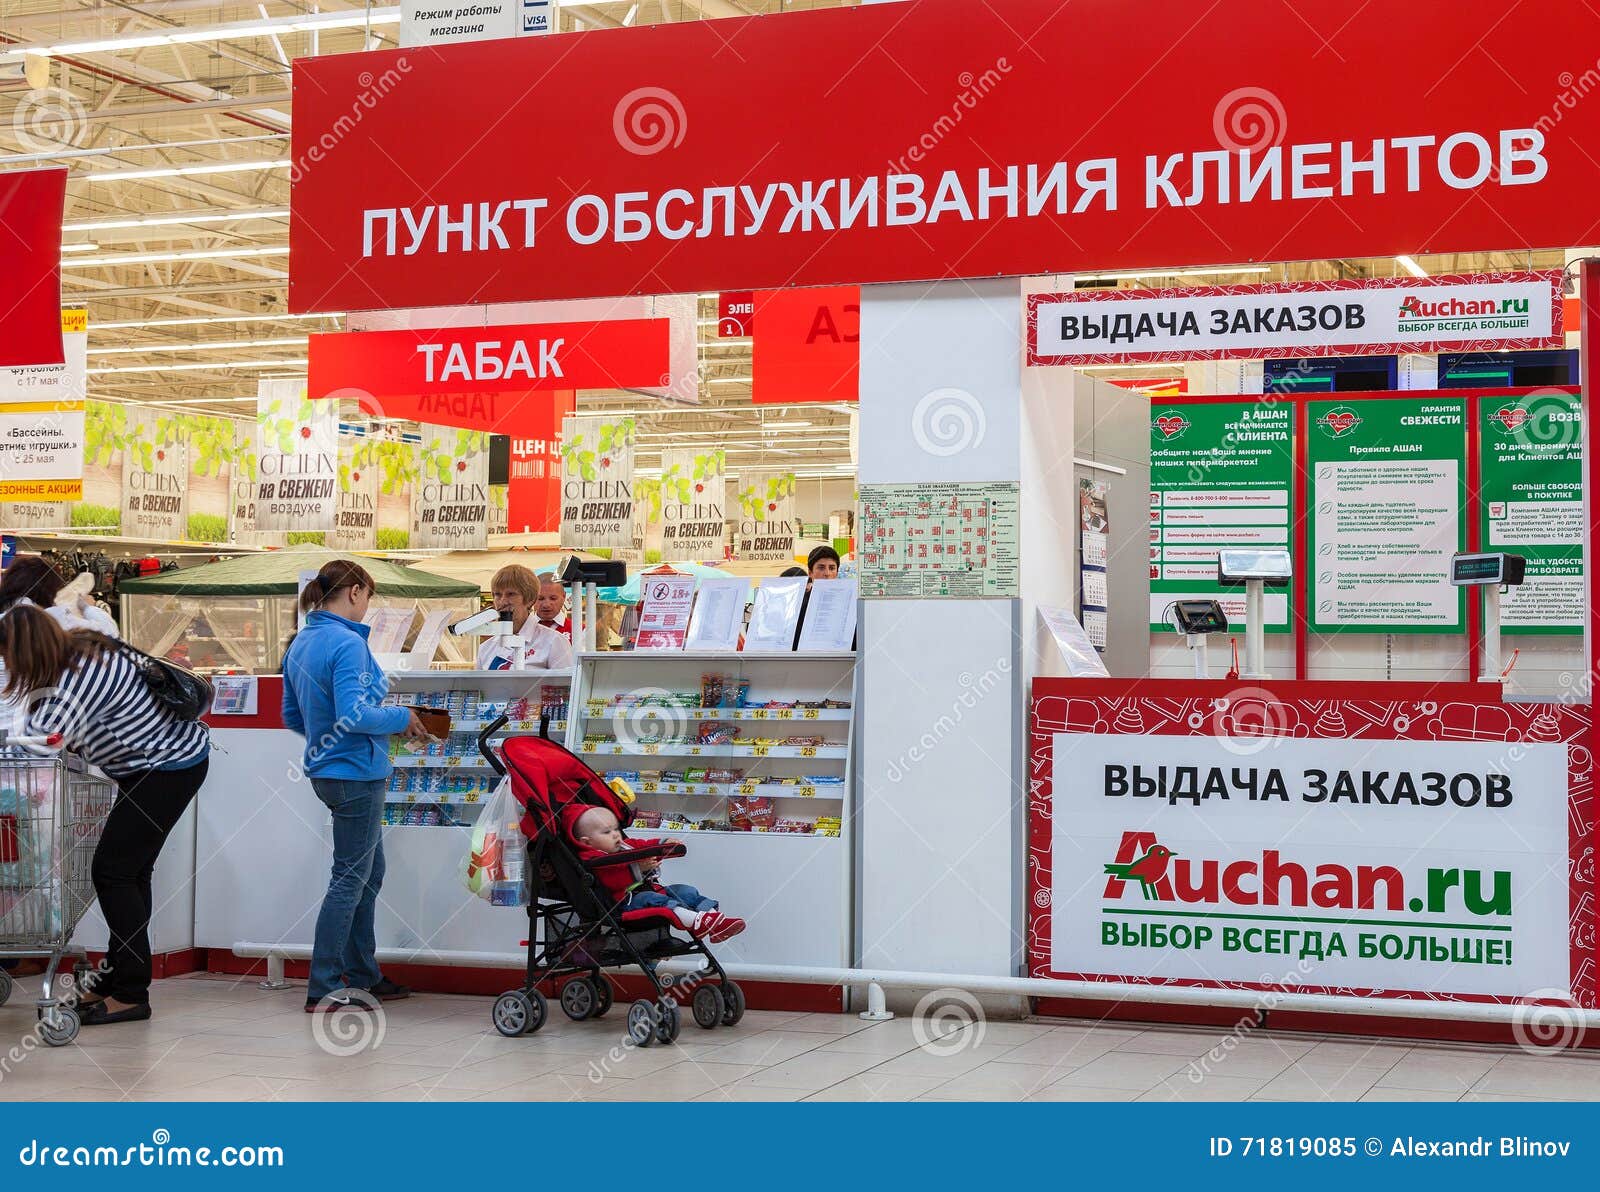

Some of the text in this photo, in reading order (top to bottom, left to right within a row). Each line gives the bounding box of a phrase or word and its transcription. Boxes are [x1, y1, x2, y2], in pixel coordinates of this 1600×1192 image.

[414, 4, 502, 21] Режим работы
[526, 15, 548, 26] VISA
[430, 25, 485, 37] магазина
[362, 128, 1549, 258] ПУНКТ ОБСЛУЖИВАНИЯ КЛИЕНТОВ
[1398, 296, 1529, 320] Auchan.ru
[726, 324, 733, 335] 1
[1060, 304, 1366, 345] ВЫДАЧА ЗАКАЗОВ
[1398, 318, 1529, 333] ВЫБОР ВСЕГДА БОЛЬШЕ!
[417, 338, 565, 383] ТАБАК
[26, 377, 37, 386] 17
[40, 378, 59, 386] мая
[1243, 410, 1288, 419] В АШАН
[1421, 405, 1461, 413] ГАРАНТИЯ
[1239, 422, 1288, 430] НАЧИНАЕТСЯ
[1400, 415, 1461, 426] СВЕЖЕСТИ
[1227, 432, 1288, 441] С КЛИЕНТА
[0, 441, 26, 451] етние
[513, 440, 545, 458] ЦЕН
[1350, 444, 1422, 455] Правила АШАН
[1494, 443, 1507, 451] 30
[1508, 442, 1532, 451] дней
[1212, 448, 1236, 456] Ваше
[1498, 454, 1515, 462] для
[1518, 453, 1564, 461] Клиентов
[23, 454, 34, 464] 25
[36, 455, 55, 463] мая
[1186, 458, 1258, 468] гипермаркетах!
[0, 484, 81, 495] ЕЗОННЫЕ АКЦИИ
[259, 483, 274, 499] на
[279, 479, 335, 499] СВЕЖЕМ
[129, 495, 181, 513] на СВЕЖЕМ
[13, 504, 55, 519] воздухе
[236, 504, 247, 518] на
[422, 508, 436, 523] на
[438, 505, 486, 522] СВЕЖЕМ
[564, 502, 632, 520] на СВЕЖЕМ
[664, 522, 723, 538] на СВЕЖЕМ
[741, 536, 793, 551] на СВЕЖЕМ
[671, 588, 690, 599] 18+
[591, 708, 600, 717] 24
[755, 710, 764, 718] 14
[780, 710, 788, 718] 14
[805, 709, 815, 718] 25
[583, 744, 593, 752] 30
[756, 747, 764, 756] 14
[803, 747, 813, 756] 25
[644, 782, 654, 791] 25
[742, 785, 752, 794] 22
[802, 787, 812, 796] 25
[1104, 764, 1513, 808] ВЫДАЧА ЗАКАЗОВ
[1103, 830, 1513, 916] Auchan.ru
[1101, 921, 1513, 966] ВЫБОР ВСЕГДА БОЛЬШЕ!
